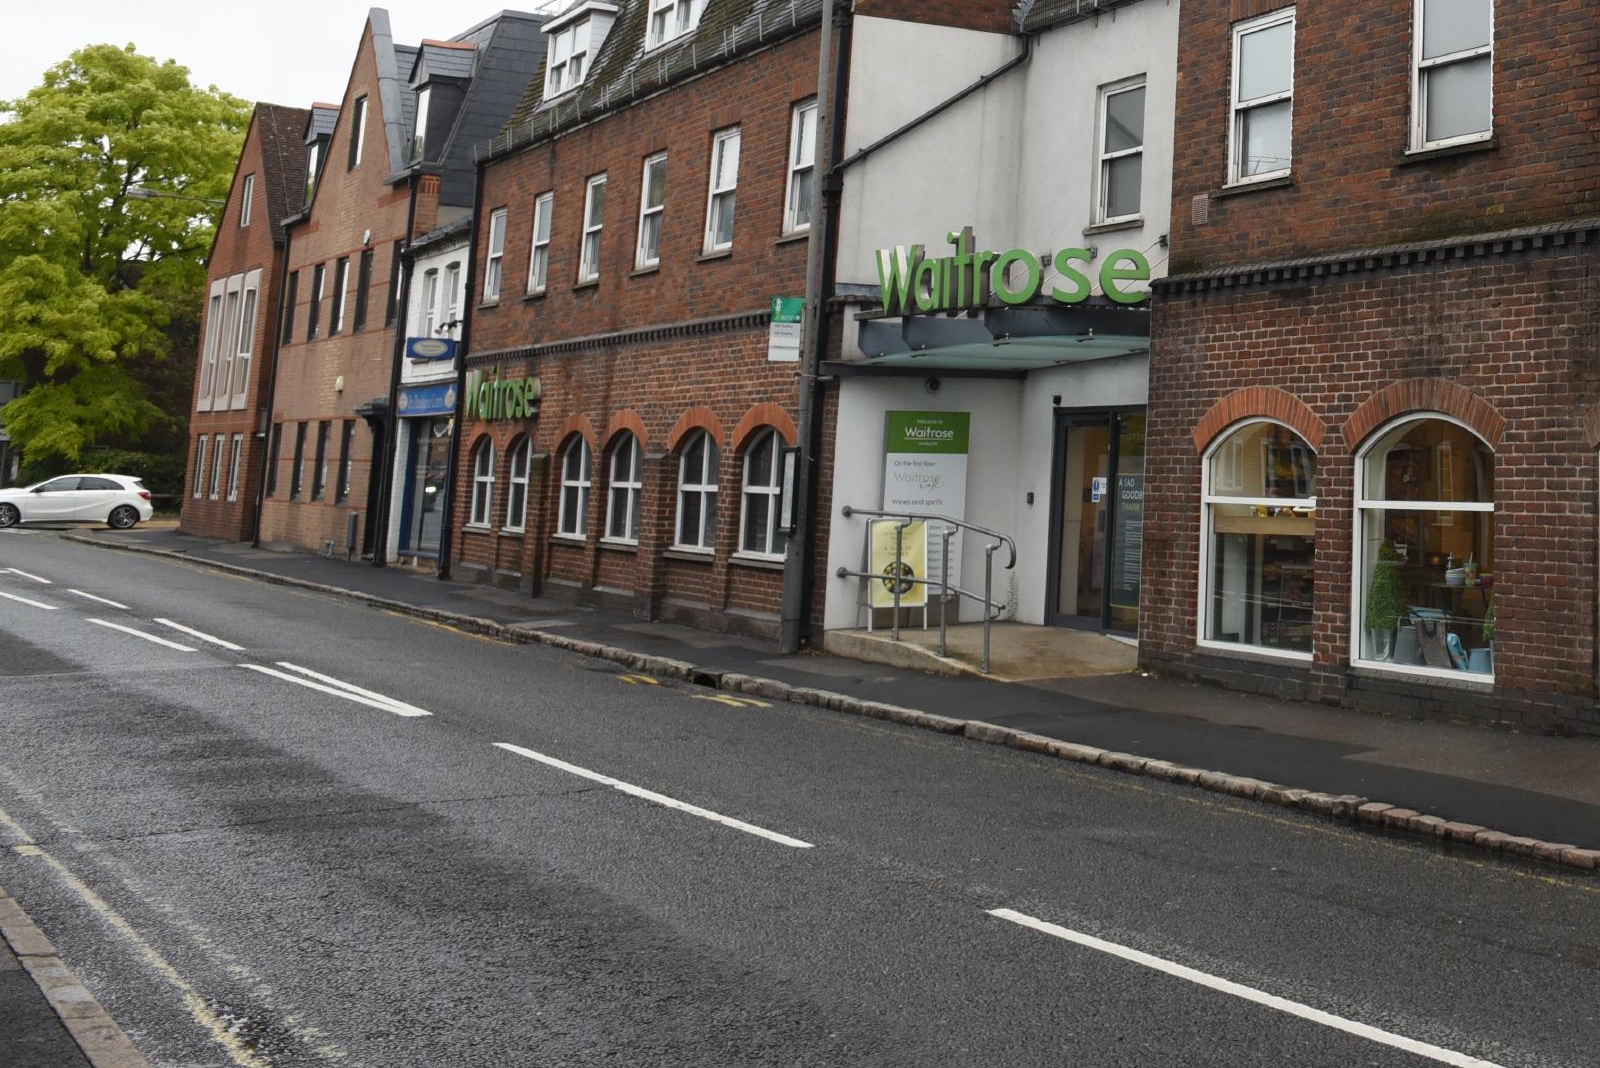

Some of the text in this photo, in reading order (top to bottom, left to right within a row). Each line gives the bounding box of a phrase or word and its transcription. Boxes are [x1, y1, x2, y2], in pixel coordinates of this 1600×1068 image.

[875, 226, 1151, 316] Waitrose
[465, 364, 541, 420] Waitrose
[904, 426, 954, 438] Waitrose
